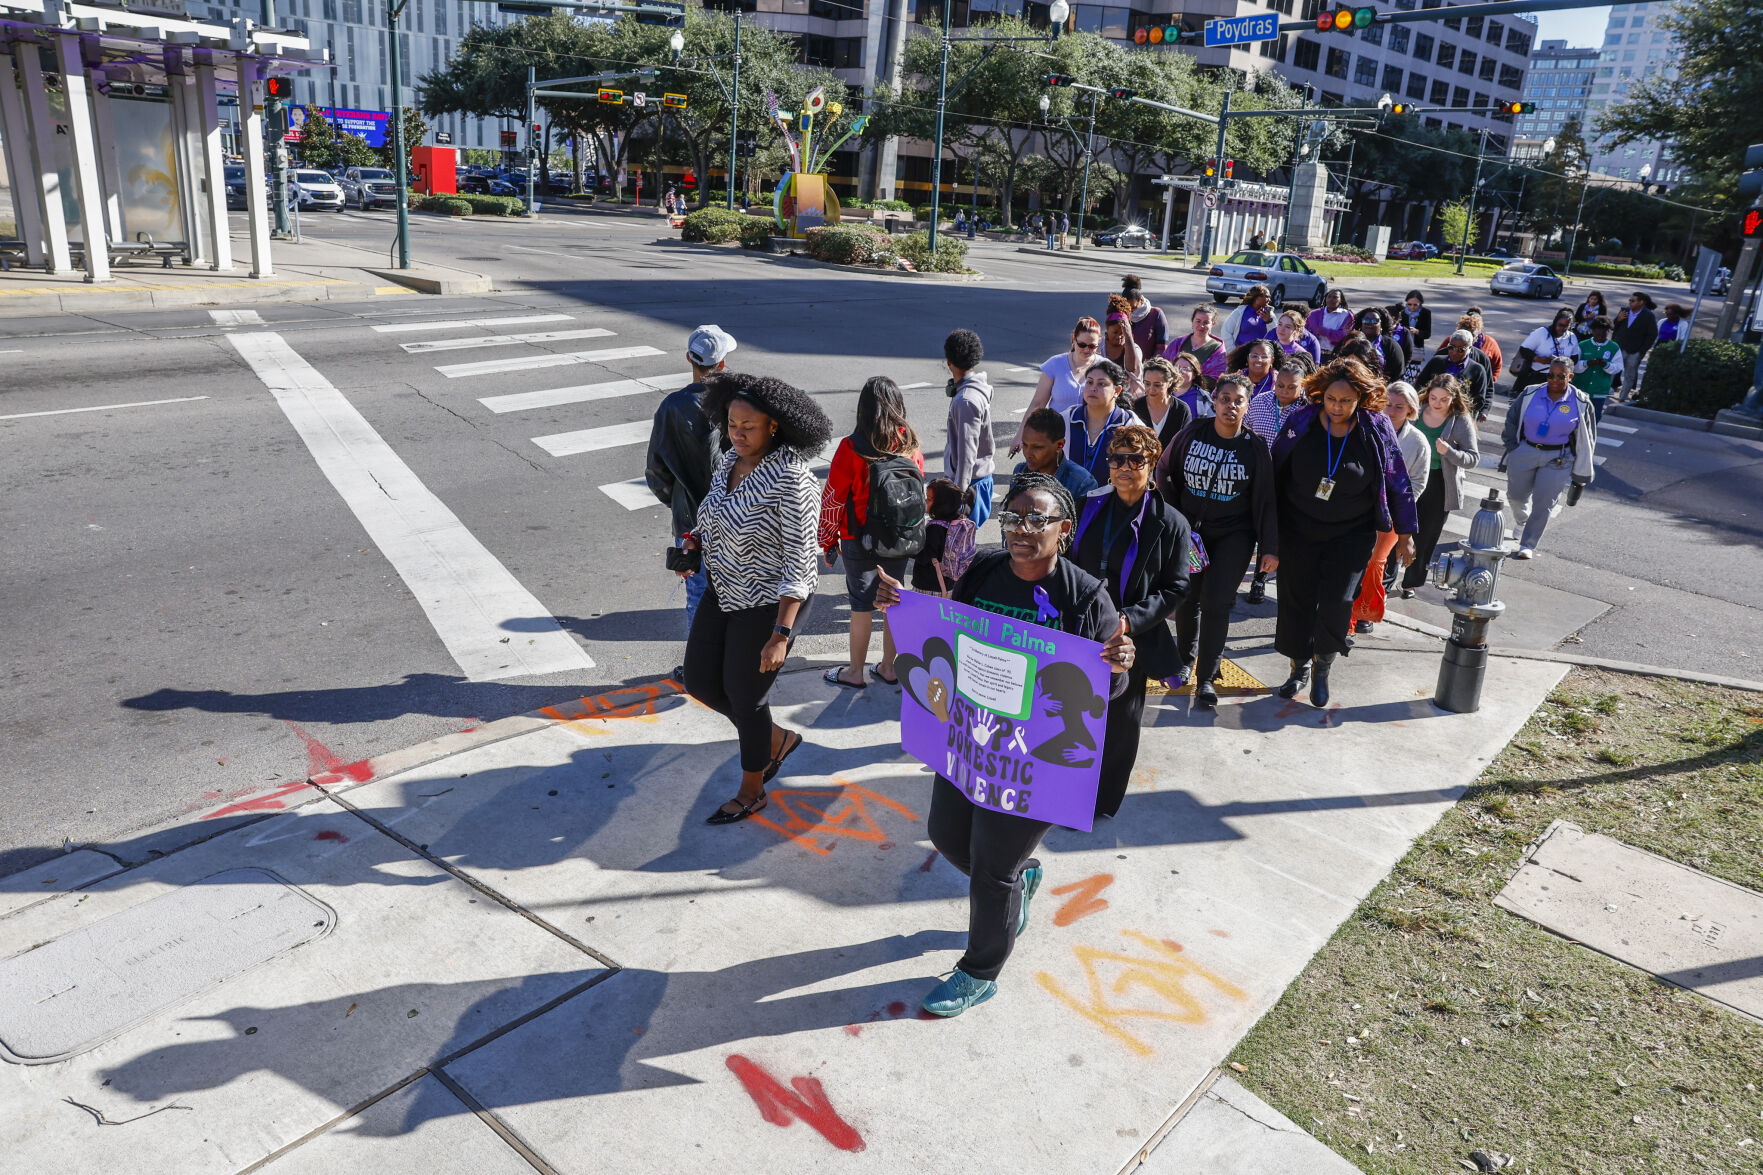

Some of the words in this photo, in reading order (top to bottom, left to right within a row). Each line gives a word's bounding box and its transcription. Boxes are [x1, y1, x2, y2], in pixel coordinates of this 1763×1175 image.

[1217, 18, 1273, 42] Poydras
[1187, 439, 1238, 463] EDUCATE.
[938, 602, 990, 637] Lizzell
[1001, 623, 1056, 655] Palma
[953, 697, 1014, 753] STP
[946, 751, 1032, 813] VIOLENCE
[947, 724, 1034, 786] DOMESTIC
